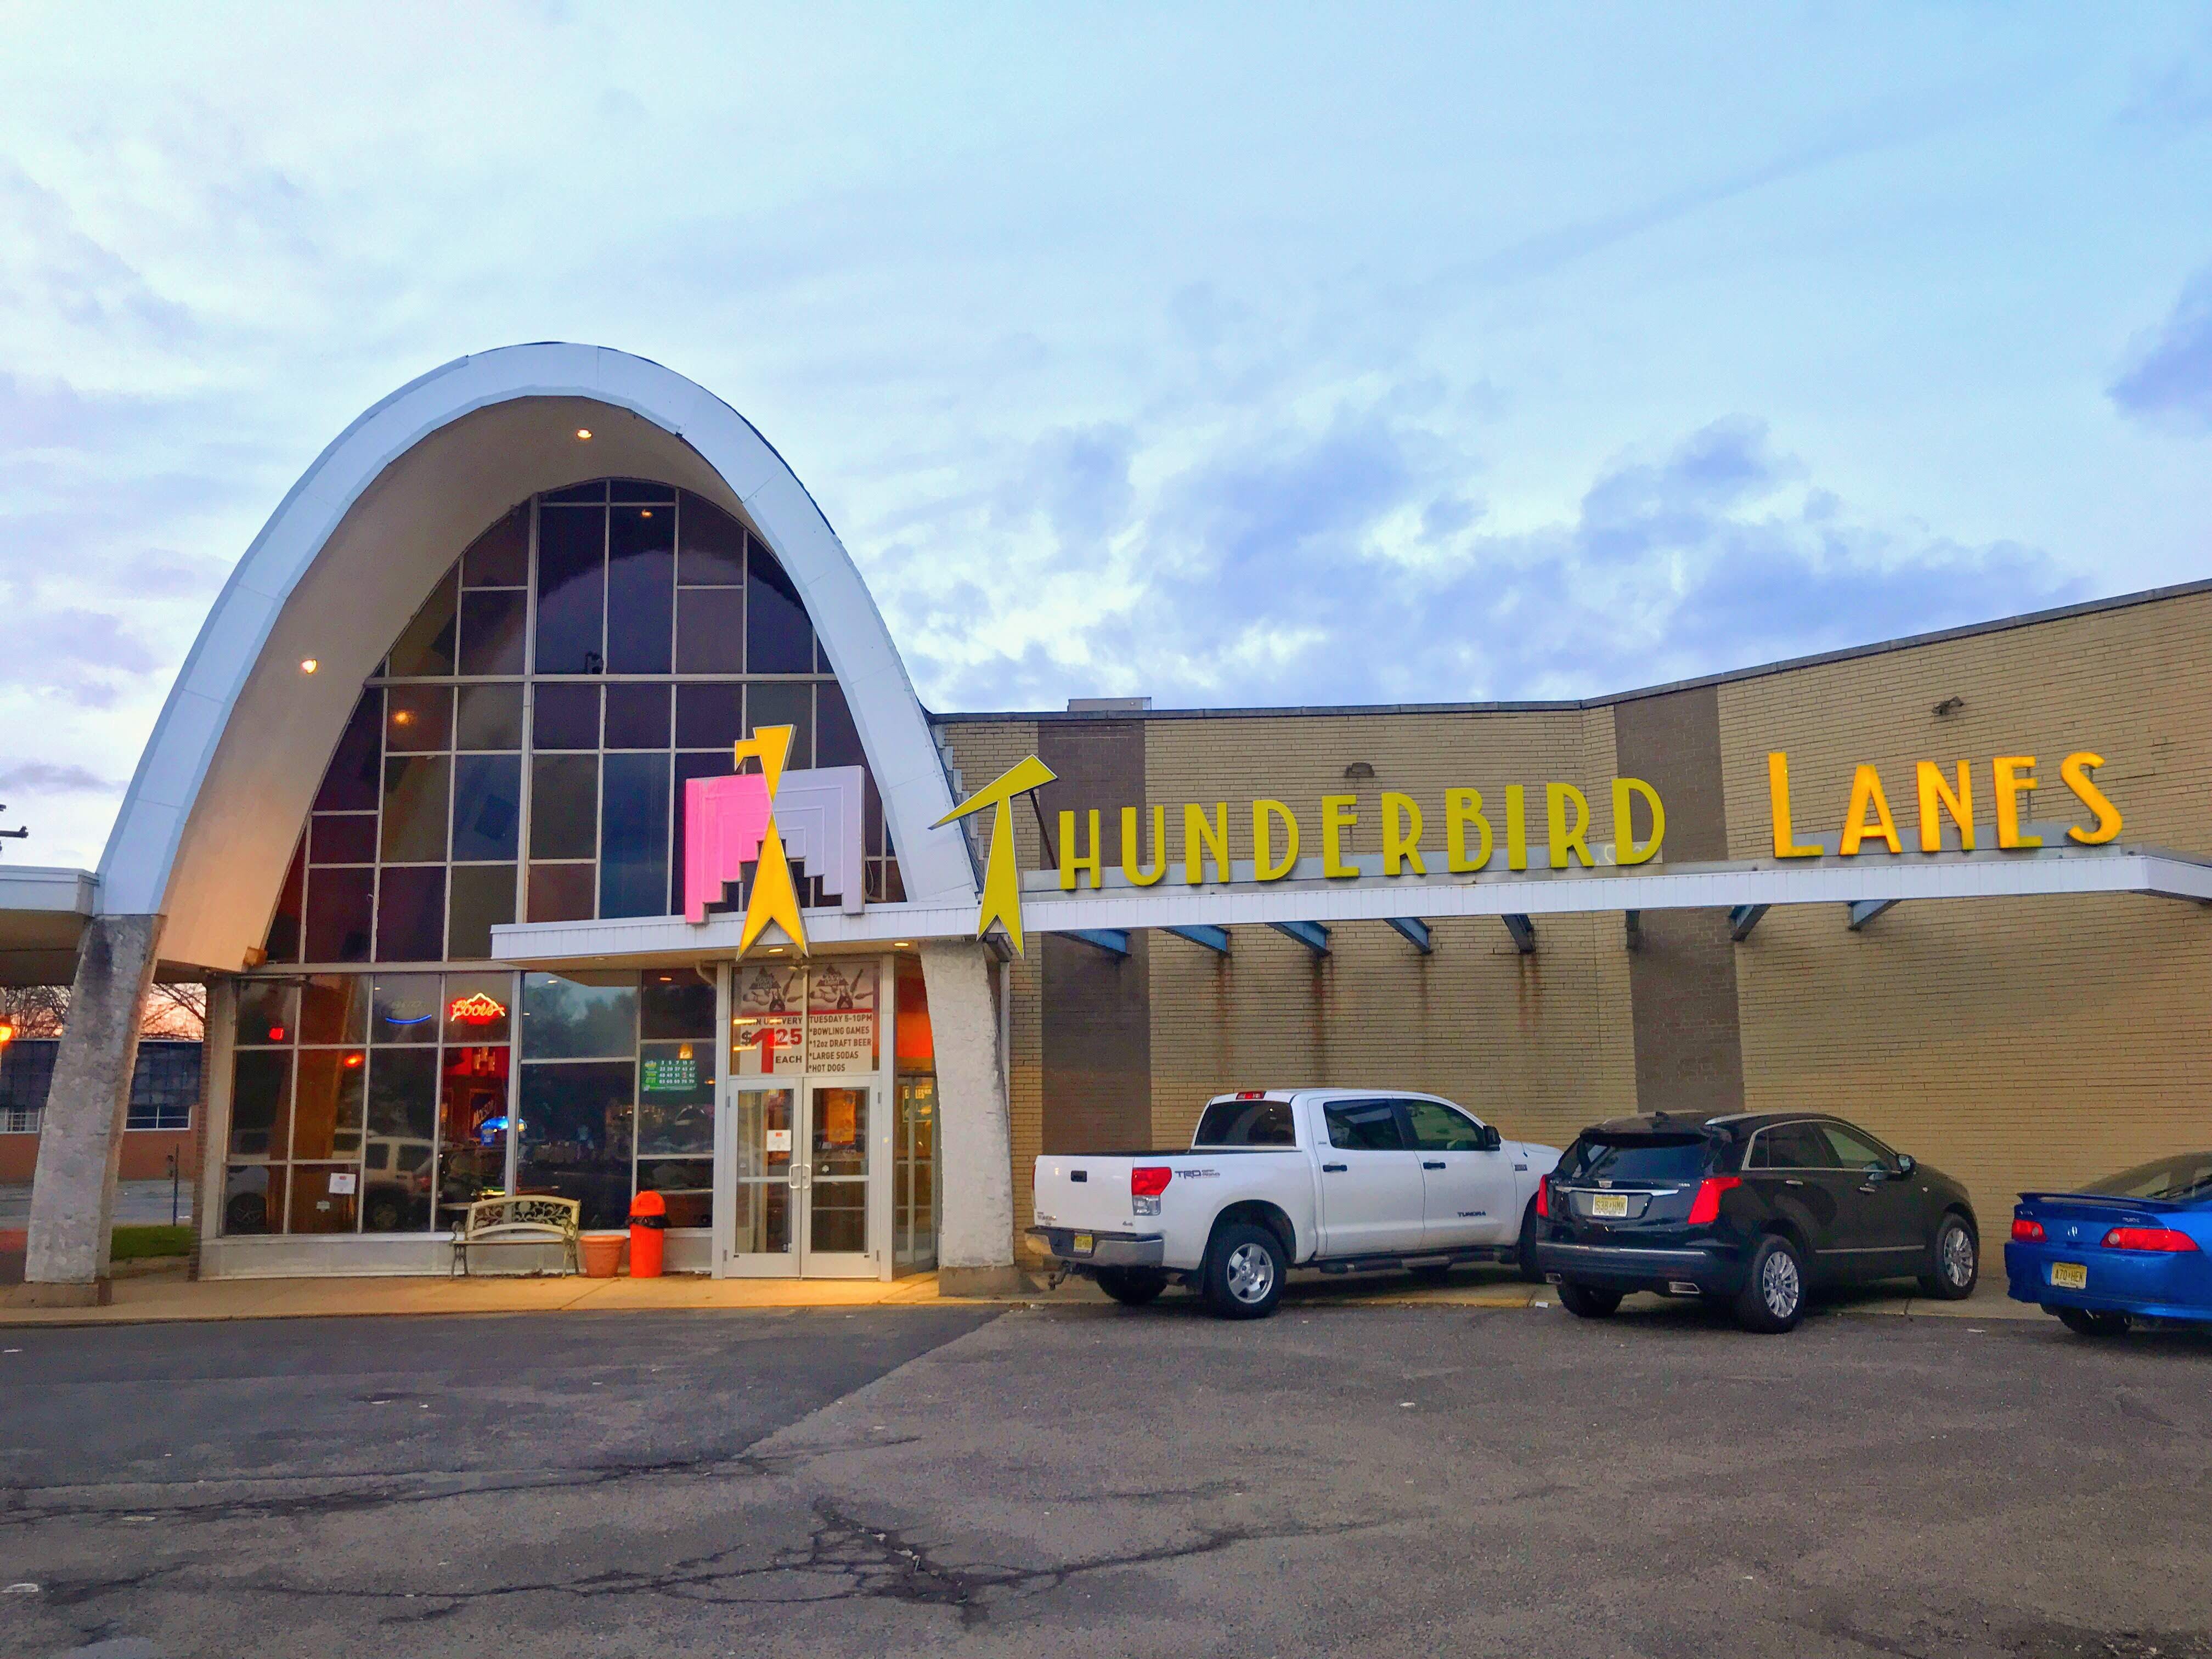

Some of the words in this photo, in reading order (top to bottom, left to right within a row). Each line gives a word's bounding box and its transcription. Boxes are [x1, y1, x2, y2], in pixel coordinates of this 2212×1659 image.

[928, 754, 1666, 960] THUNDERBIRD
[1768, 752, 2123, 859] LANES
[452, 999, 505, 1017] Coors
[809, 1015, 843, 1023] TUESDAY
[812, 1027, 844, 1035] BOWLING
[846, 1026, 870, 1034] GAMES
[830, 1039, 851, 1047] DRAFT
[854, 1039, 872, 1047] BEER
[812, 1052, 834, 1060] LARGE
[836, 1051, 859, 1059] SODAS
[827, 1063, 845, 1072] DOGS
[1175, 1170, 1201, 1179] TRD
